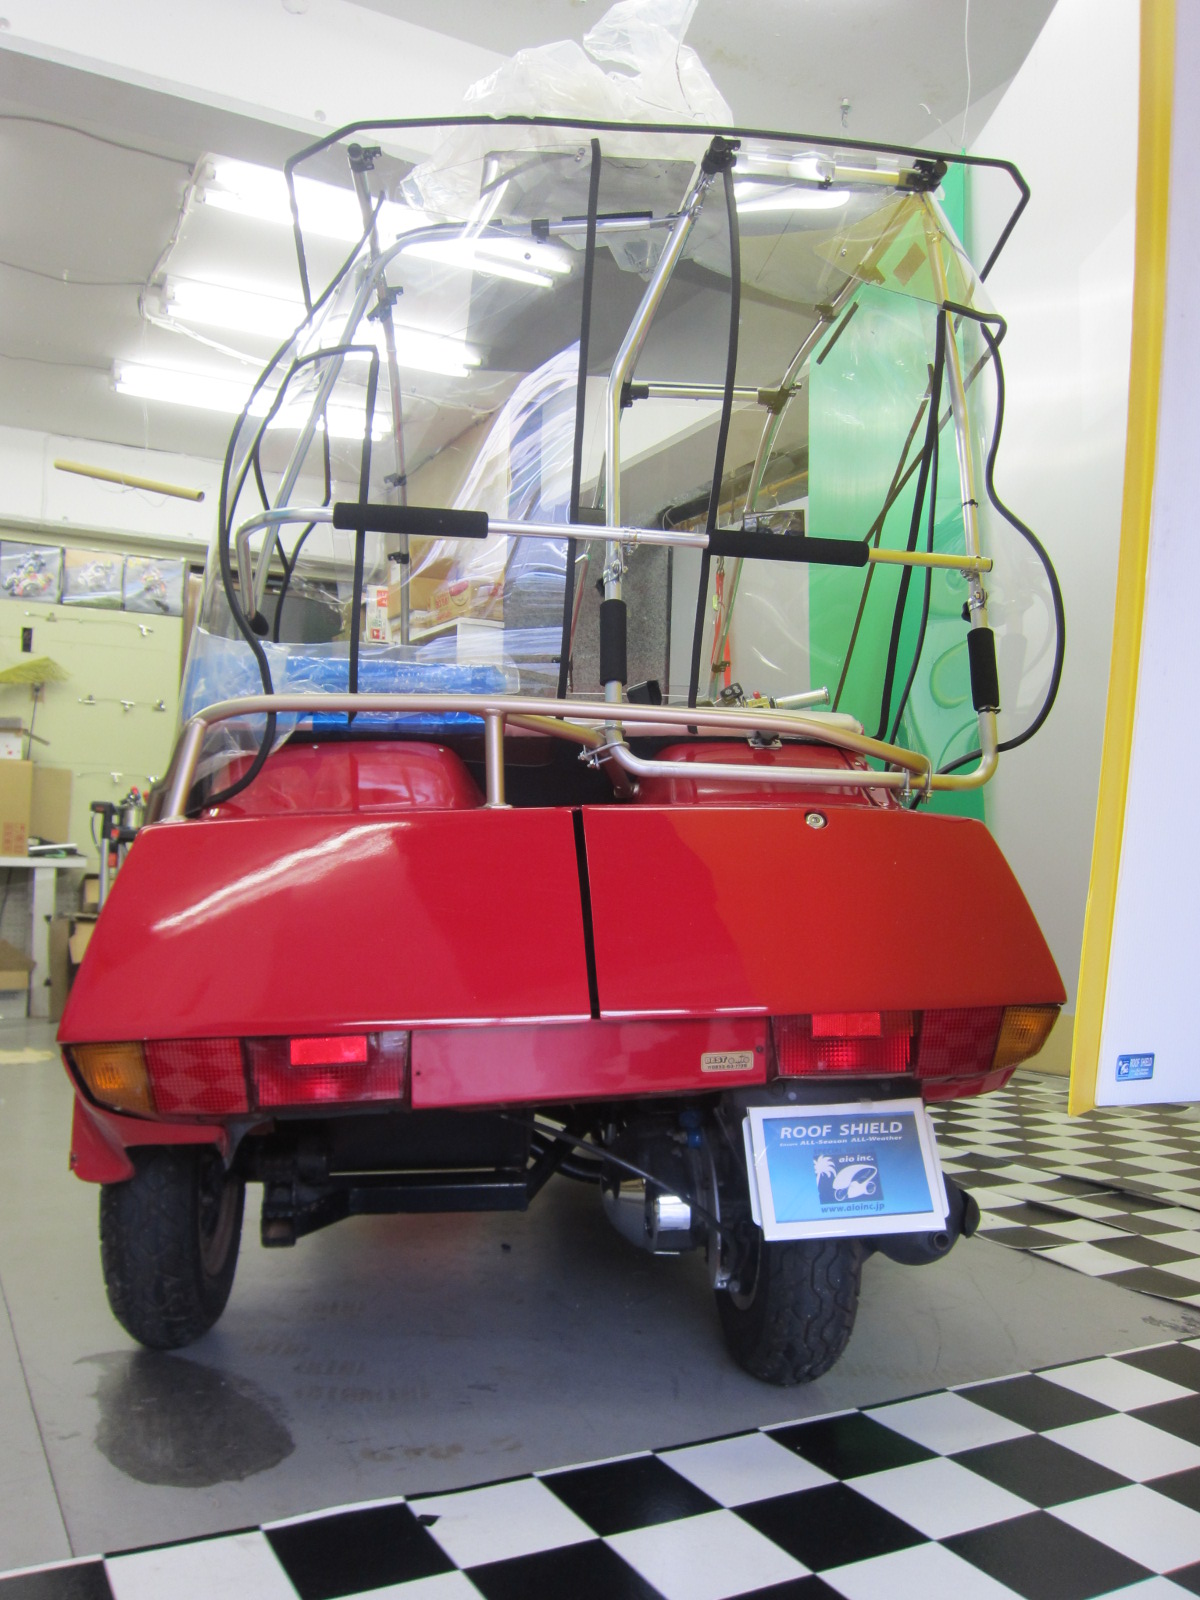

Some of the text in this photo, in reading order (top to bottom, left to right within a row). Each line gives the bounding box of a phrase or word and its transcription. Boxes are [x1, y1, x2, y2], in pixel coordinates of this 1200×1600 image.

[705, 1056, 727, 1064] BEST
[780, 1121, 903, 1139] ROOF SHIELD
[799, 1138, 848, 1146] ALL-Season
[851, 1135, 903, 1143] ALL-Weather
[856, 1154, 874, 1162] inc.
[821, 1202, 885, 1213] www.aioinc.jp
